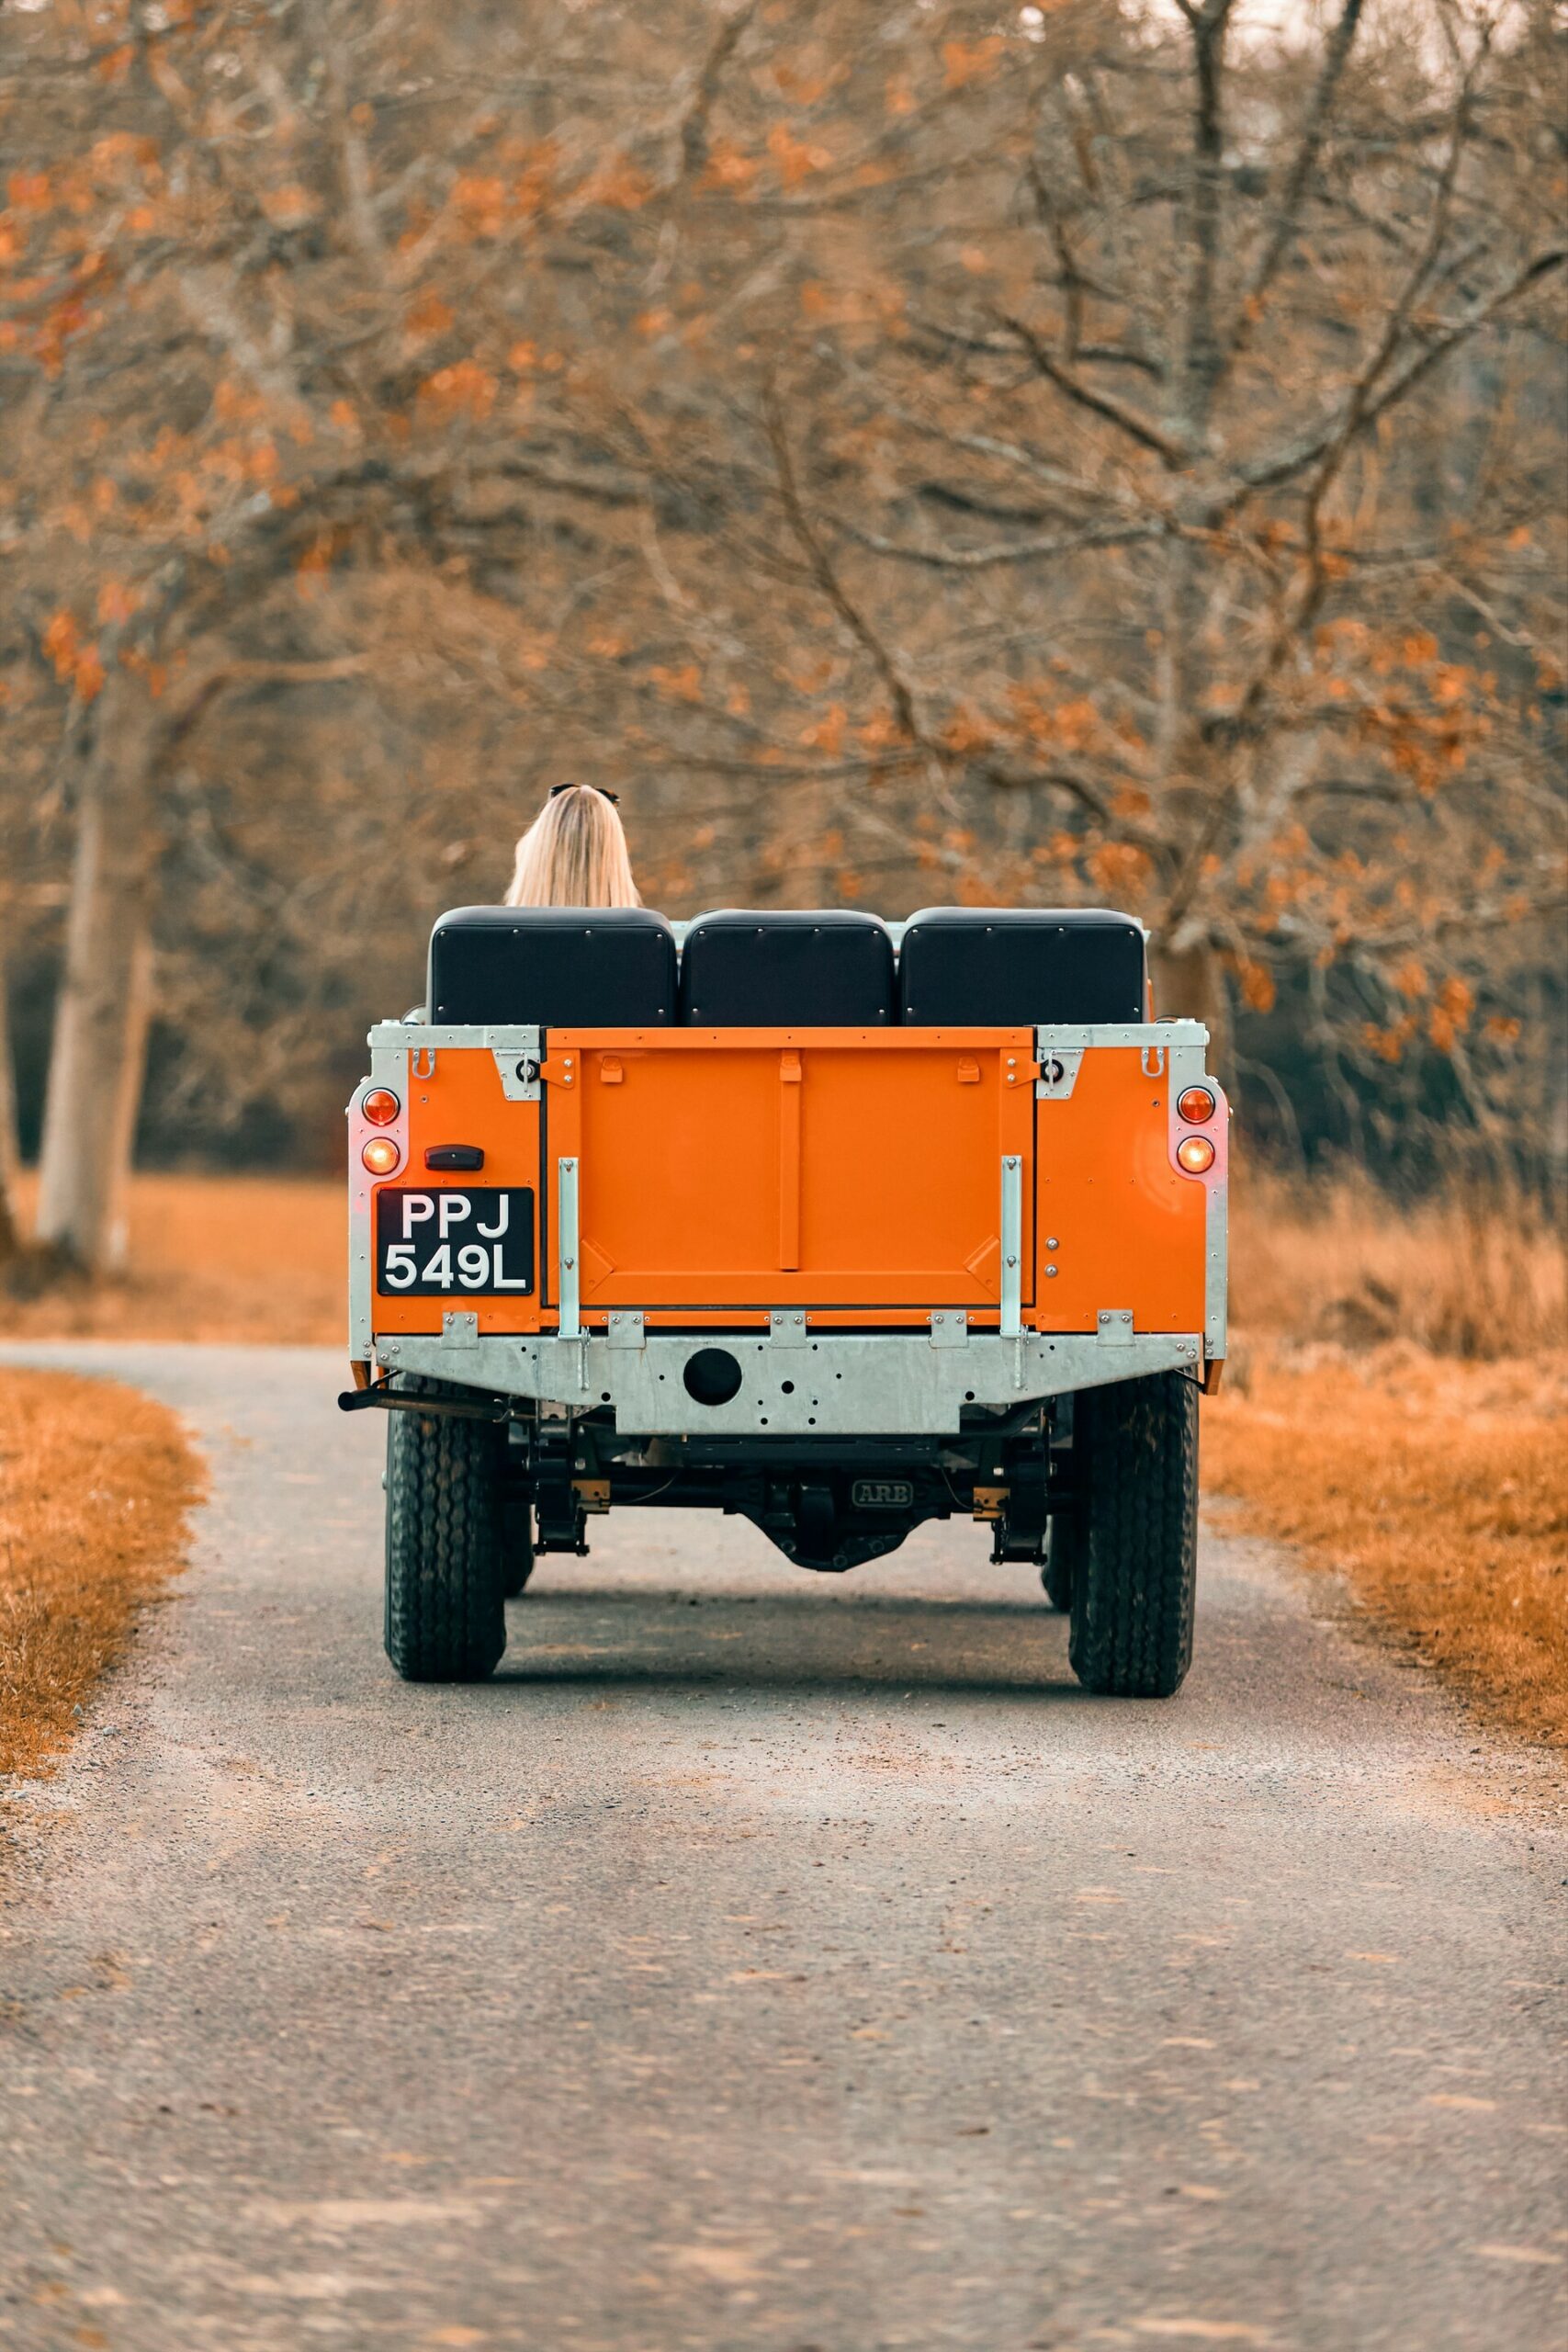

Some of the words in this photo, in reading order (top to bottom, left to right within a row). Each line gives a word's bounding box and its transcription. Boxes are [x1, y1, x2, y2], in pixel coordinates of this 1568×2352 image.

[402, 1193, 509, 1238] PPJ
[385, 1244, 526, 1289] 549L
[859, 1485, 908, 1502] ARB
